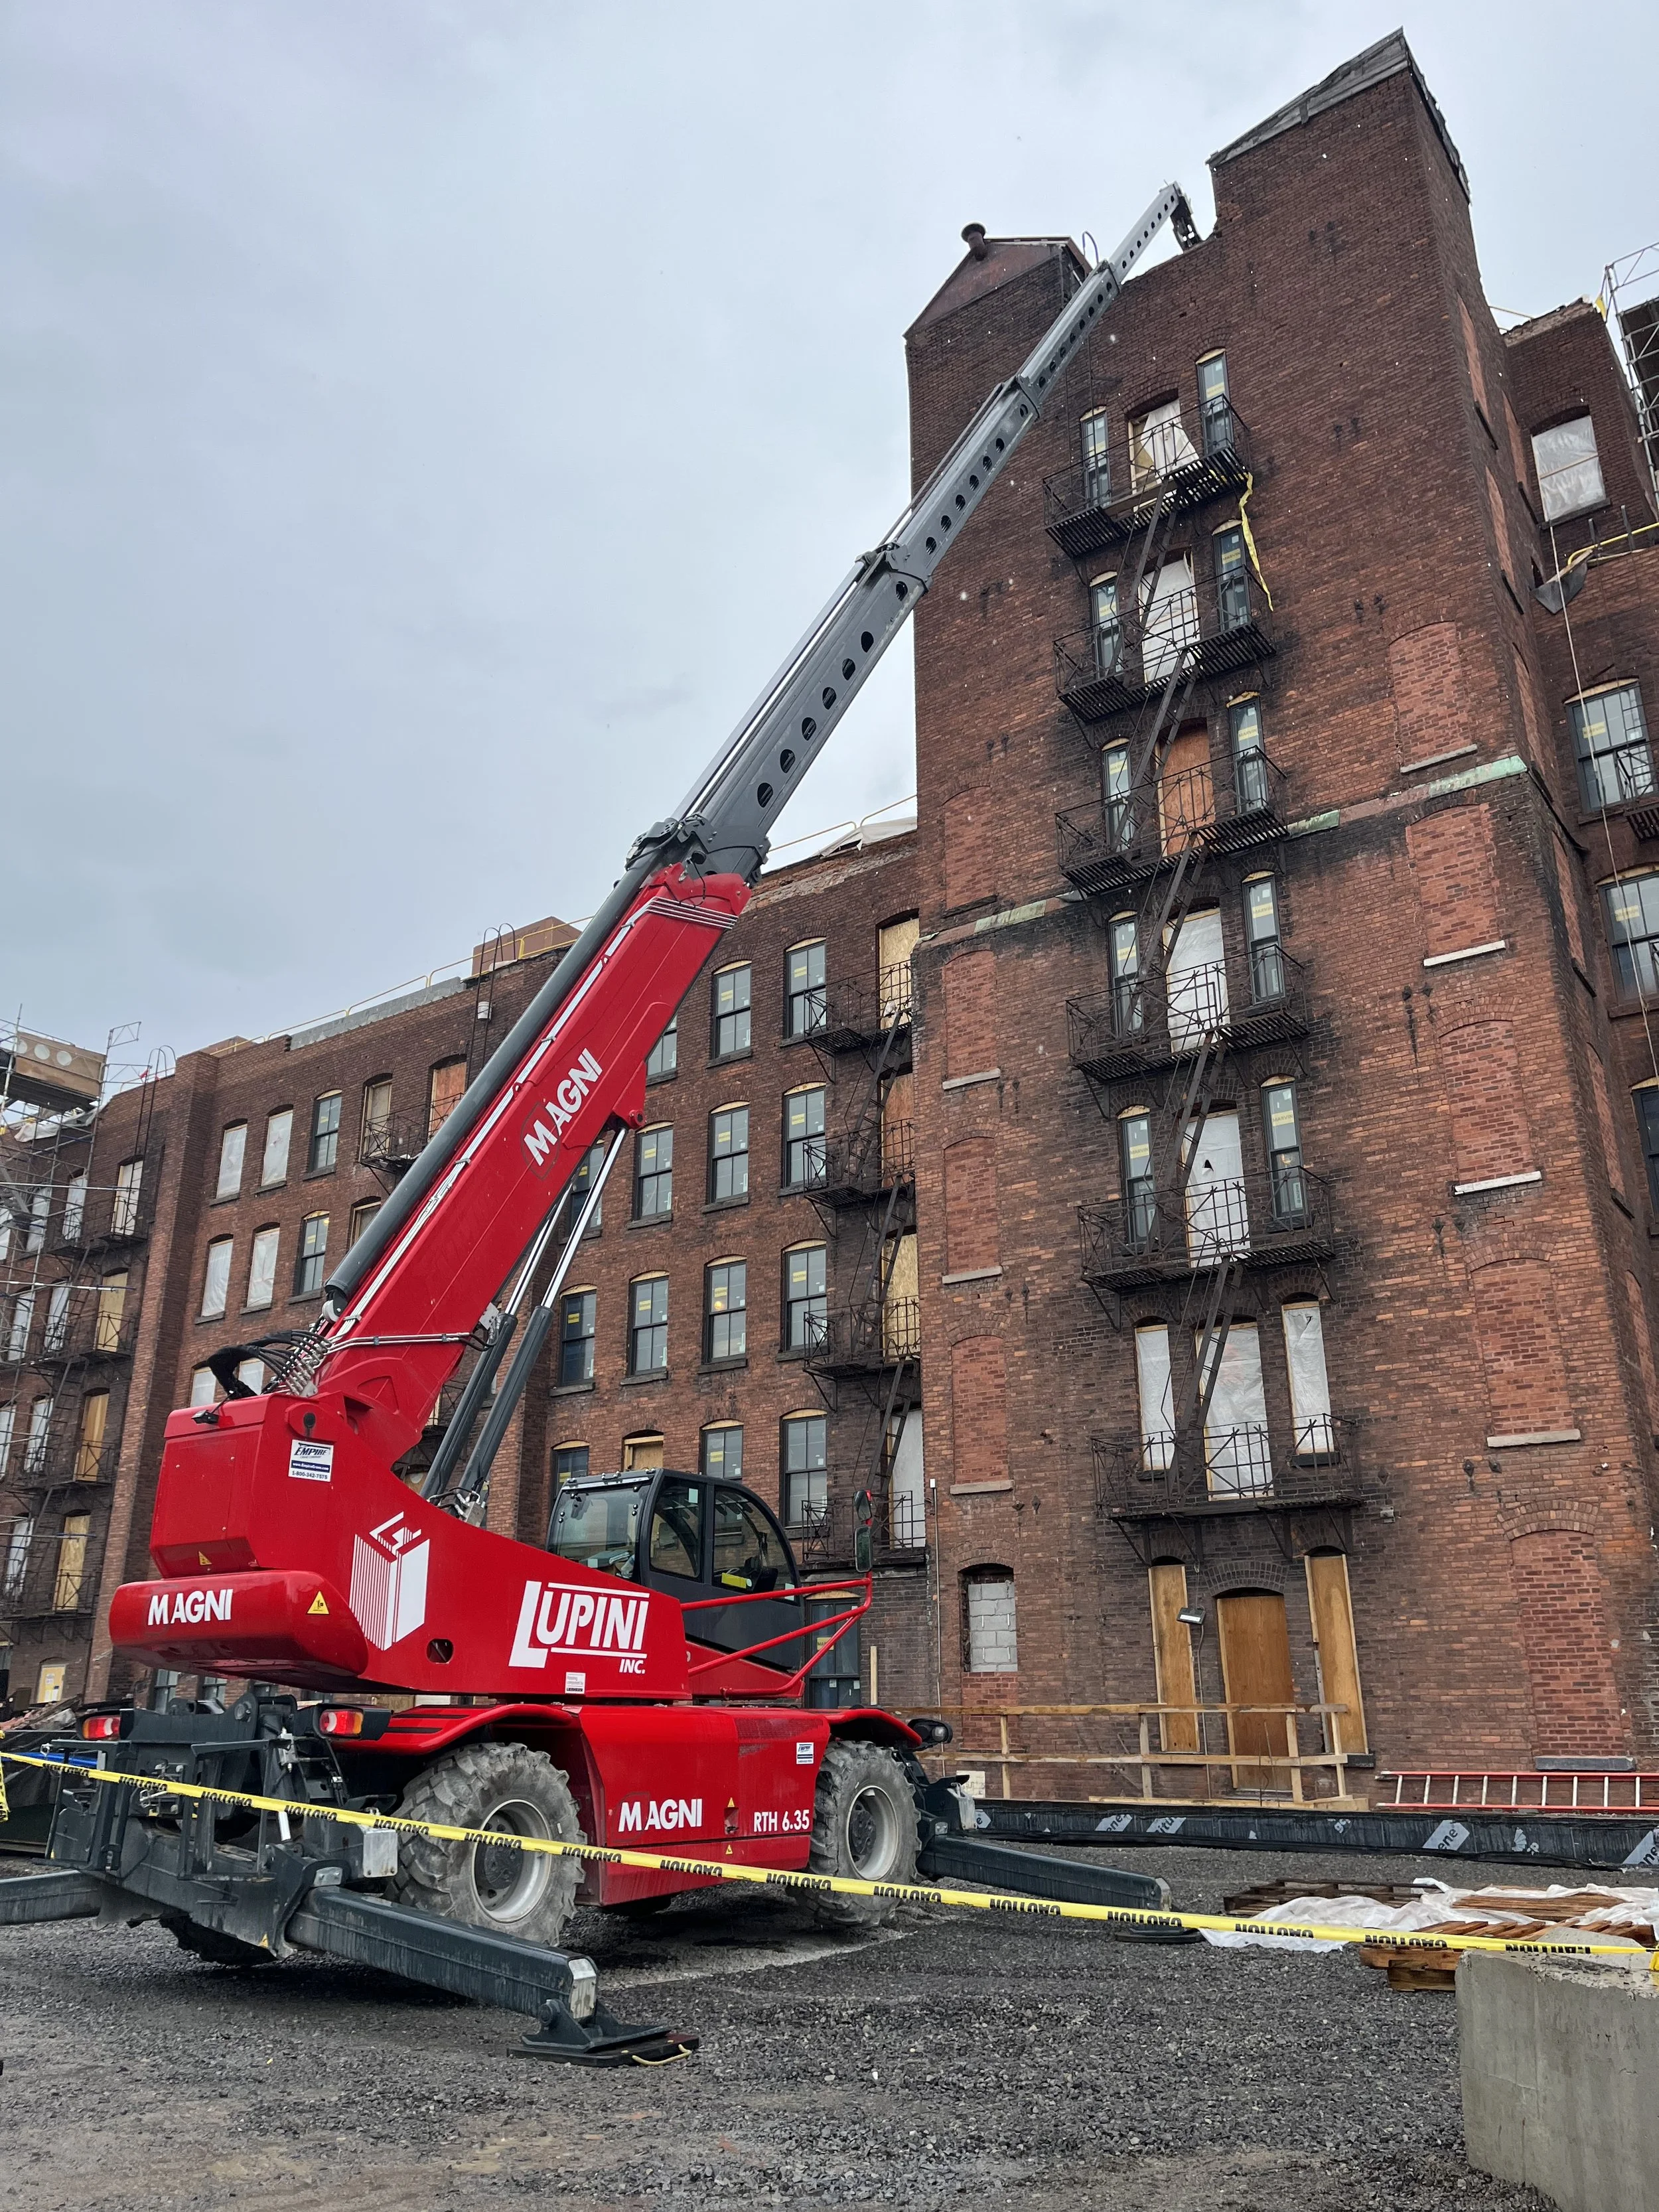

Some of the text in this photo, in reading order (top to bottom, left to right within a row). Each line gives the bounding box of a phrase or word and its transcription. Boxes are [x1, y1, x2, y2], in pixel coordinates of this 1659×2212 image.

[523, 1047, 603, 1166] MAGNI
[1272, 1114, 1294, 1123] MARVIN
[1130, 1147, 1149, 1155] MARVIN
[292, 1471, 328, 1480] 1-800-342-7575
[147, 1589, 234, 1626] MAGNI
[508, 1580, 649, 1668] LUPINI
[619, 1659, 646, 1674] INC.
[618, 1798, 703, 1832] MAGNI
[753, 1809, 810, 1832] RTH 6.35
